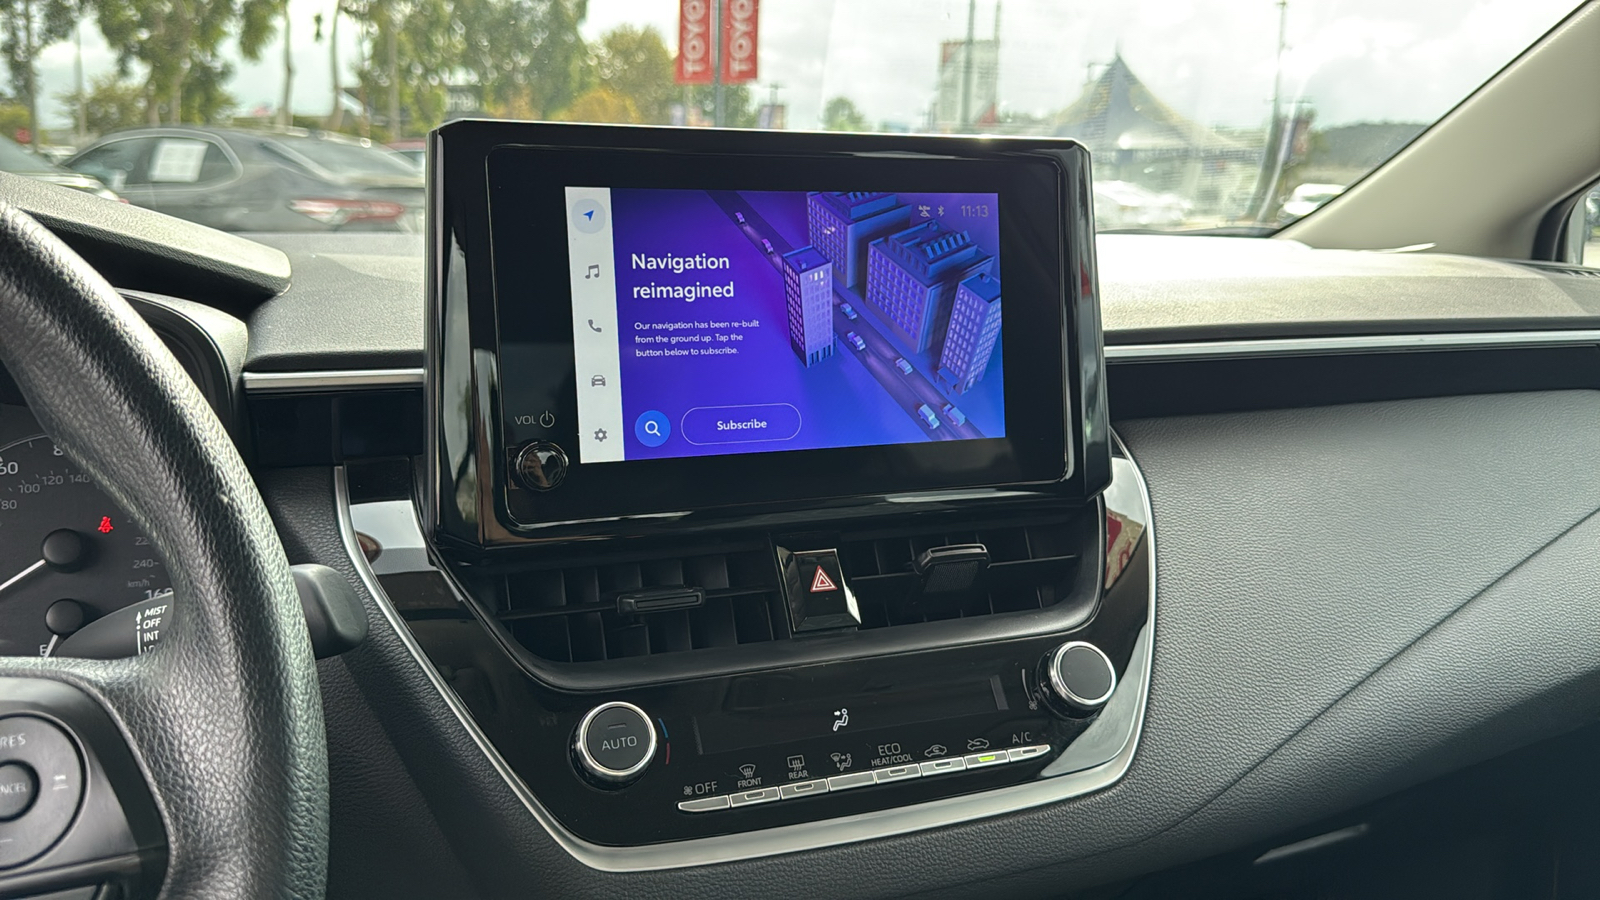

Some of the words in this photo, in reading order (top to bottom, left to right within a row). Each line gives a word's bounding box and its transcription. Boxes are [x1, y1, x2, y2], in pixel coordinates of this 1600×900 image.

[682, 0, 707, 79] TOYO
[729, 0, 755, 78] TOYO
[961, 205, 989, 218] 11:13
[631, 253, 729, 273] Navigation
[633, 281, 735, 302] reimagined
[634, 322, 650, 330] Our
[652, 321, 693, 331] navigation
[694, 320, 708, 328] has
[710, 320, 730, 329] been
[731, 320, 760, 328] re-built
[635, 335, 655, 343] from
[655, 335, 669, 343] the
[670, 334, 700, 344] ground
[701, 335, 714, 343] up.
[715, 333, 729, 342] Tap
[730, 333, 743, 341] the
[635, 348, 664, 357] button
[664, 347, 690, 356] below
[700, 347, 740, 355] subscribe.
[515, 414, 537, 425] VOL
[716, 418, 768, 432] Subscribe
[0, 461, 19, 475] 60
[41, 475, 64, 486] 120
[69, 474, 91, 484] 140
[18, 483, 40, 494] 100
[1, 499, 18, 510] 80
[133, 558, 154, 569] 240
[127, 579, 150, 588] km/h
[144, 604, 168, 618] MIST
[142, 617, 162, 630] OFF
[143, 630, 160, 643] INT
[0, 733, 26, 748] RES
[601, 735, 638, 751] AUTO
[1011, 731, 1032, 745] A/C
[878, 743, 901, 756] ECO
[871, 753, 913, 767] HEAT/COOL
[788, 770, 809, 780] REAR
[695, 781, 718, 795] OFF
[737, 777, 763, 788] FRONT
